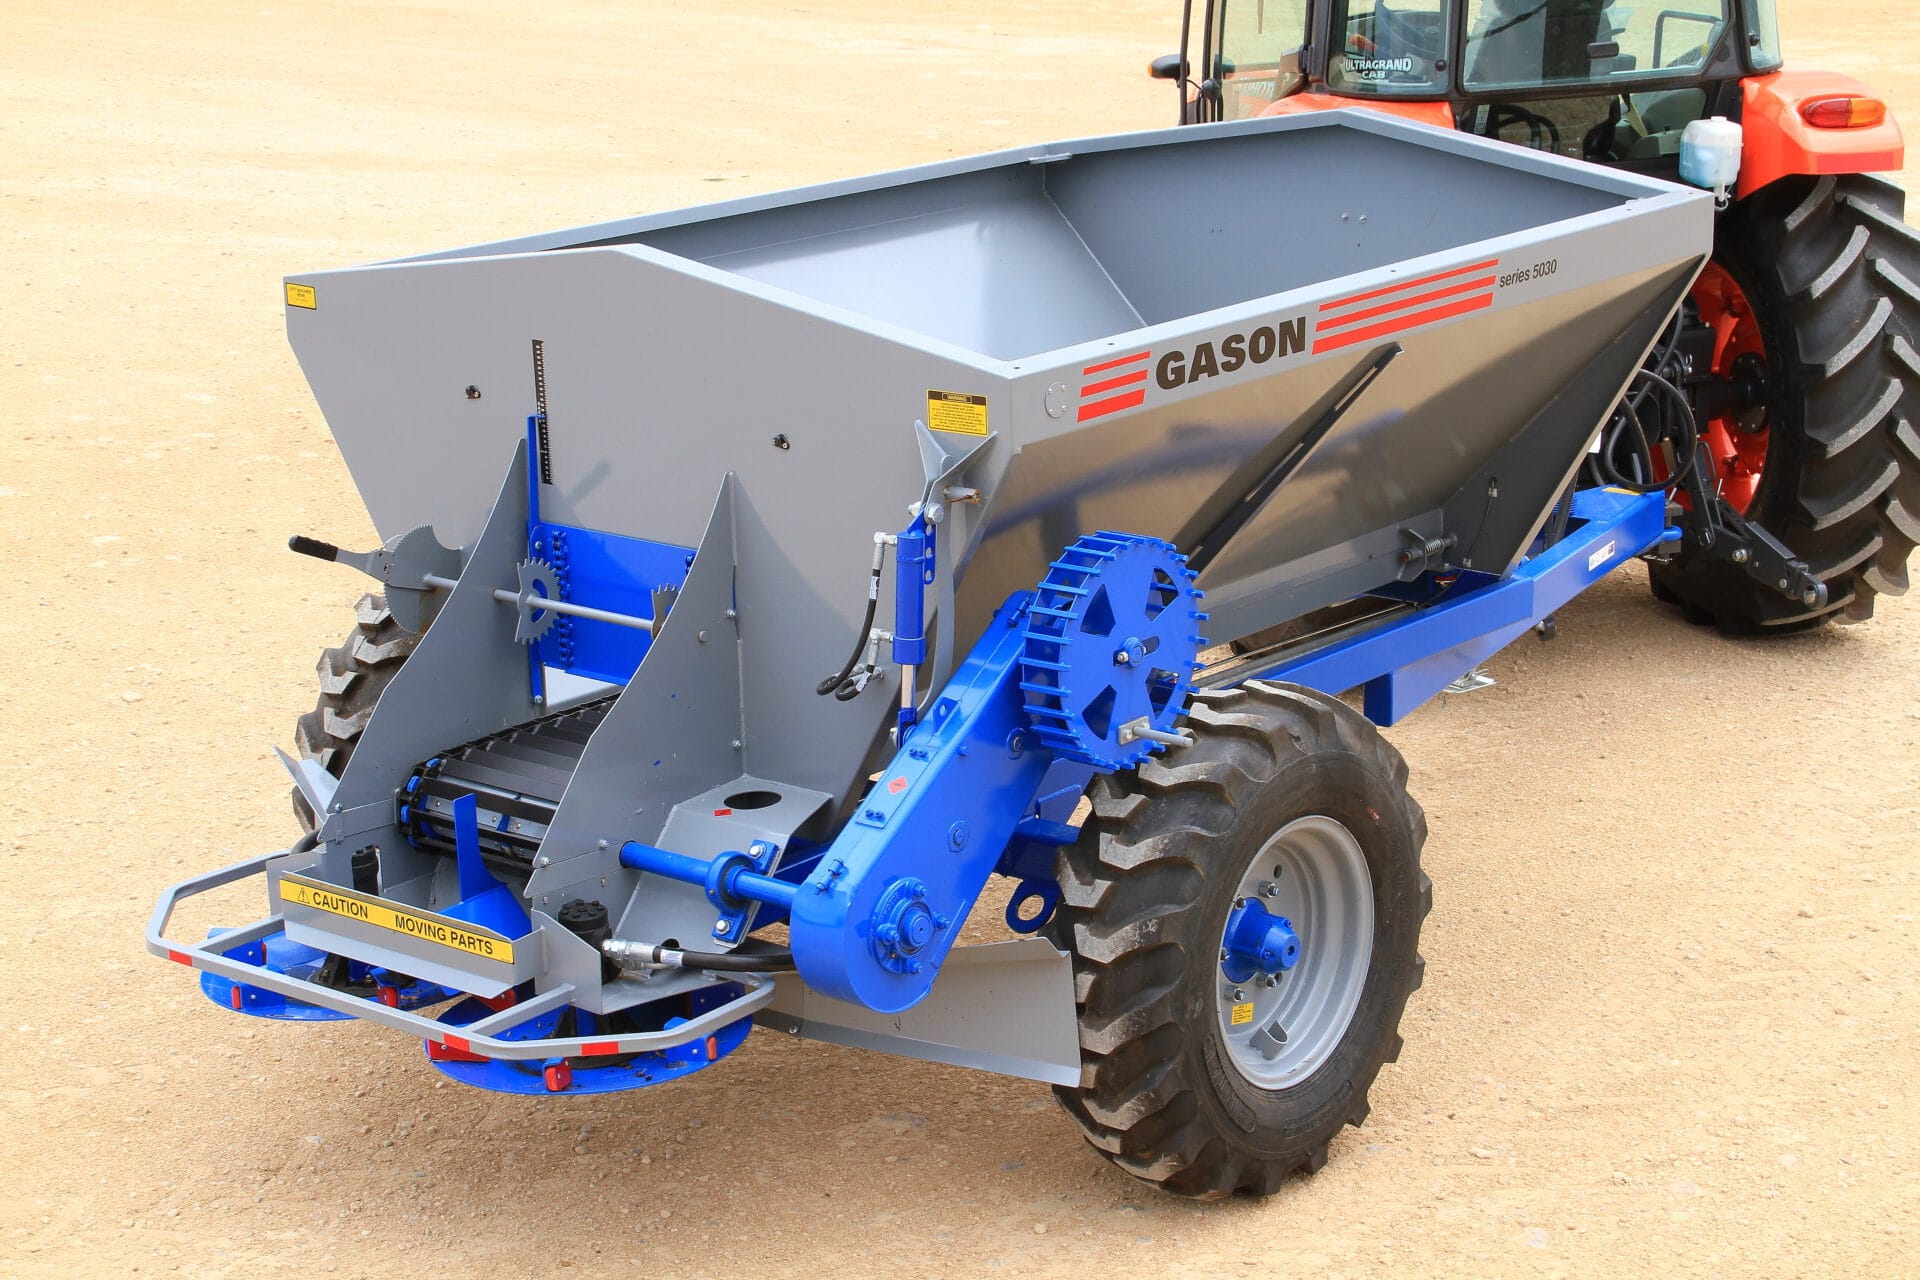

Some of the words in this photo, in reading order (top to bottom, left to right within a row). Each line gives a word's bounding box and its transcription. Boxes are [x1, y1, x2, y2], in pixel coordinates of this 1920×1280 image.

[1345, 57, 1412, 72] ULTRAGRAND
[1361, 71, 1387, 80] CAB
[1499, 267, 1531, 288] series
[1532, 258, 1558, 279] 5030
[1155, 315, 1306, 390] GASON
[313, 892, 369, 919] CAUTION
[395, 914, 447, 942] MOVING
[450, 930, 493, 955] PARTS
